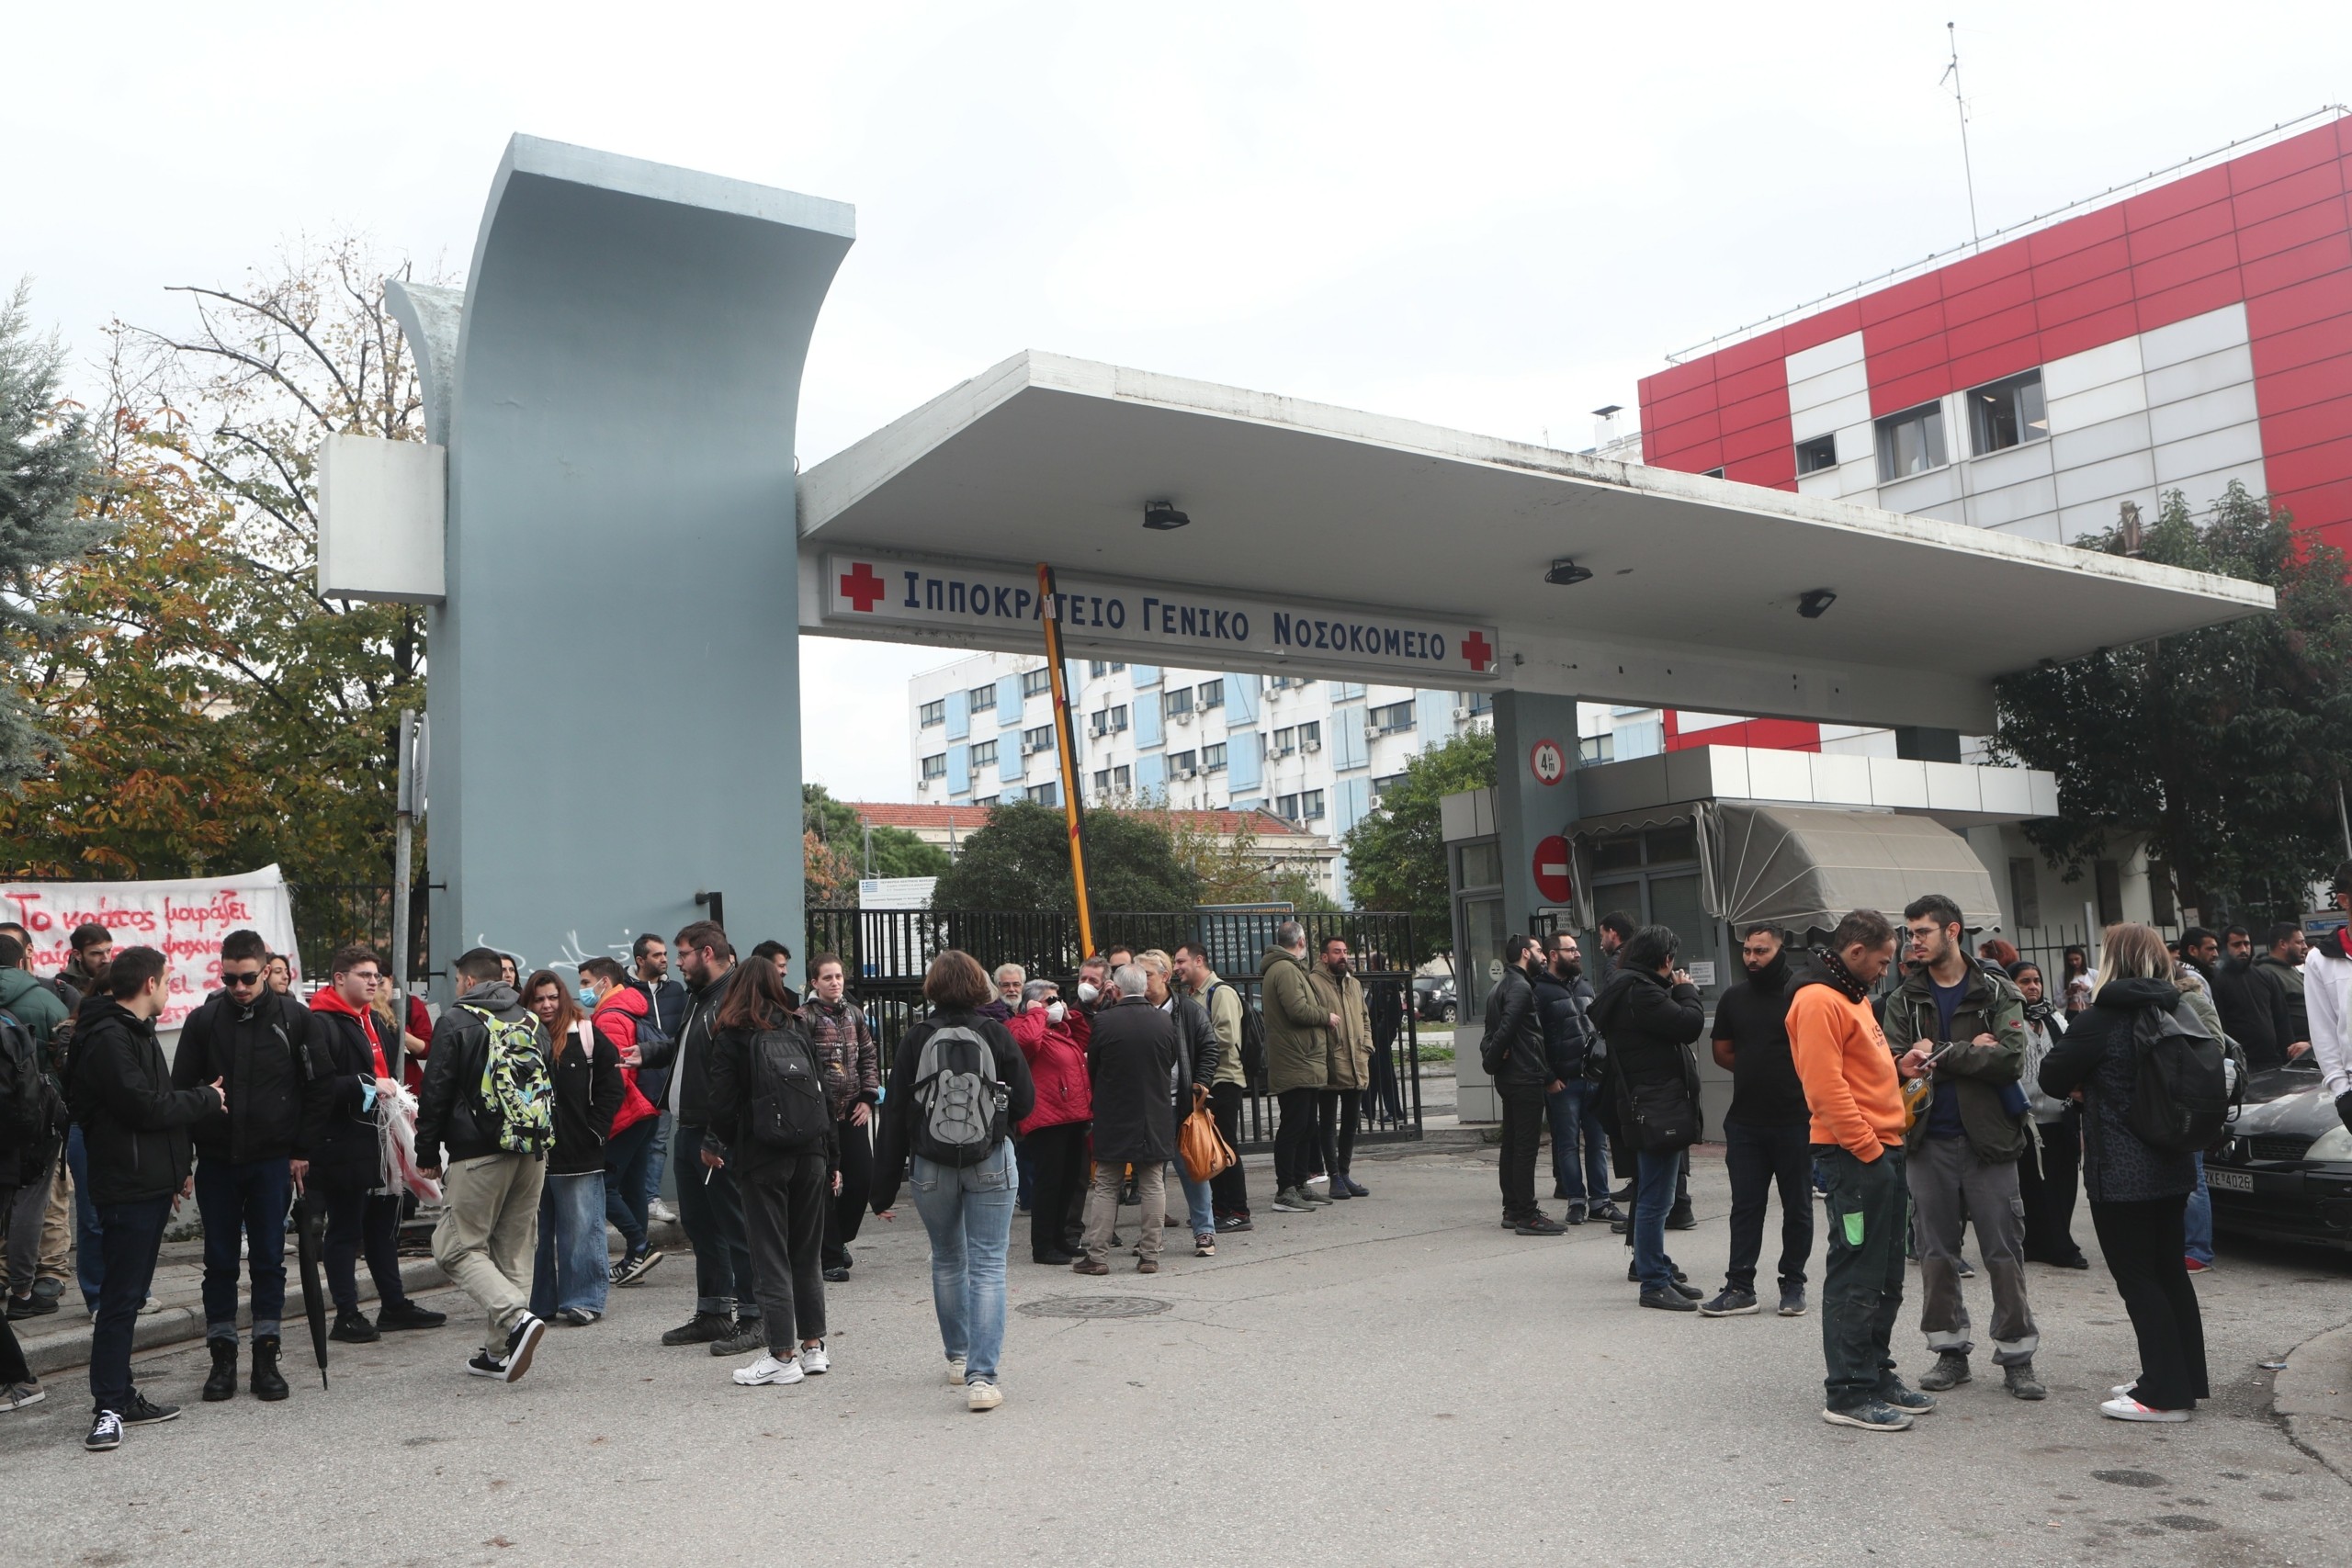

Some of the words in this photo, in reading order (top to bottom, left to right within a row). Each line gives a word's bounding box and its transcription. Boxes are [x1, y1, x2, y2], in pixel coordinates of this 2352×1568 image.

[1143, 597, 1250, 641] ΓΕΝΙΚΟ
[1273, 612, 1446, 660] ΝΟΣΟΚΟΜΕΙΟ
[1541, 752, 1548, 772] 4
[5, 892, 53, 931] Το
